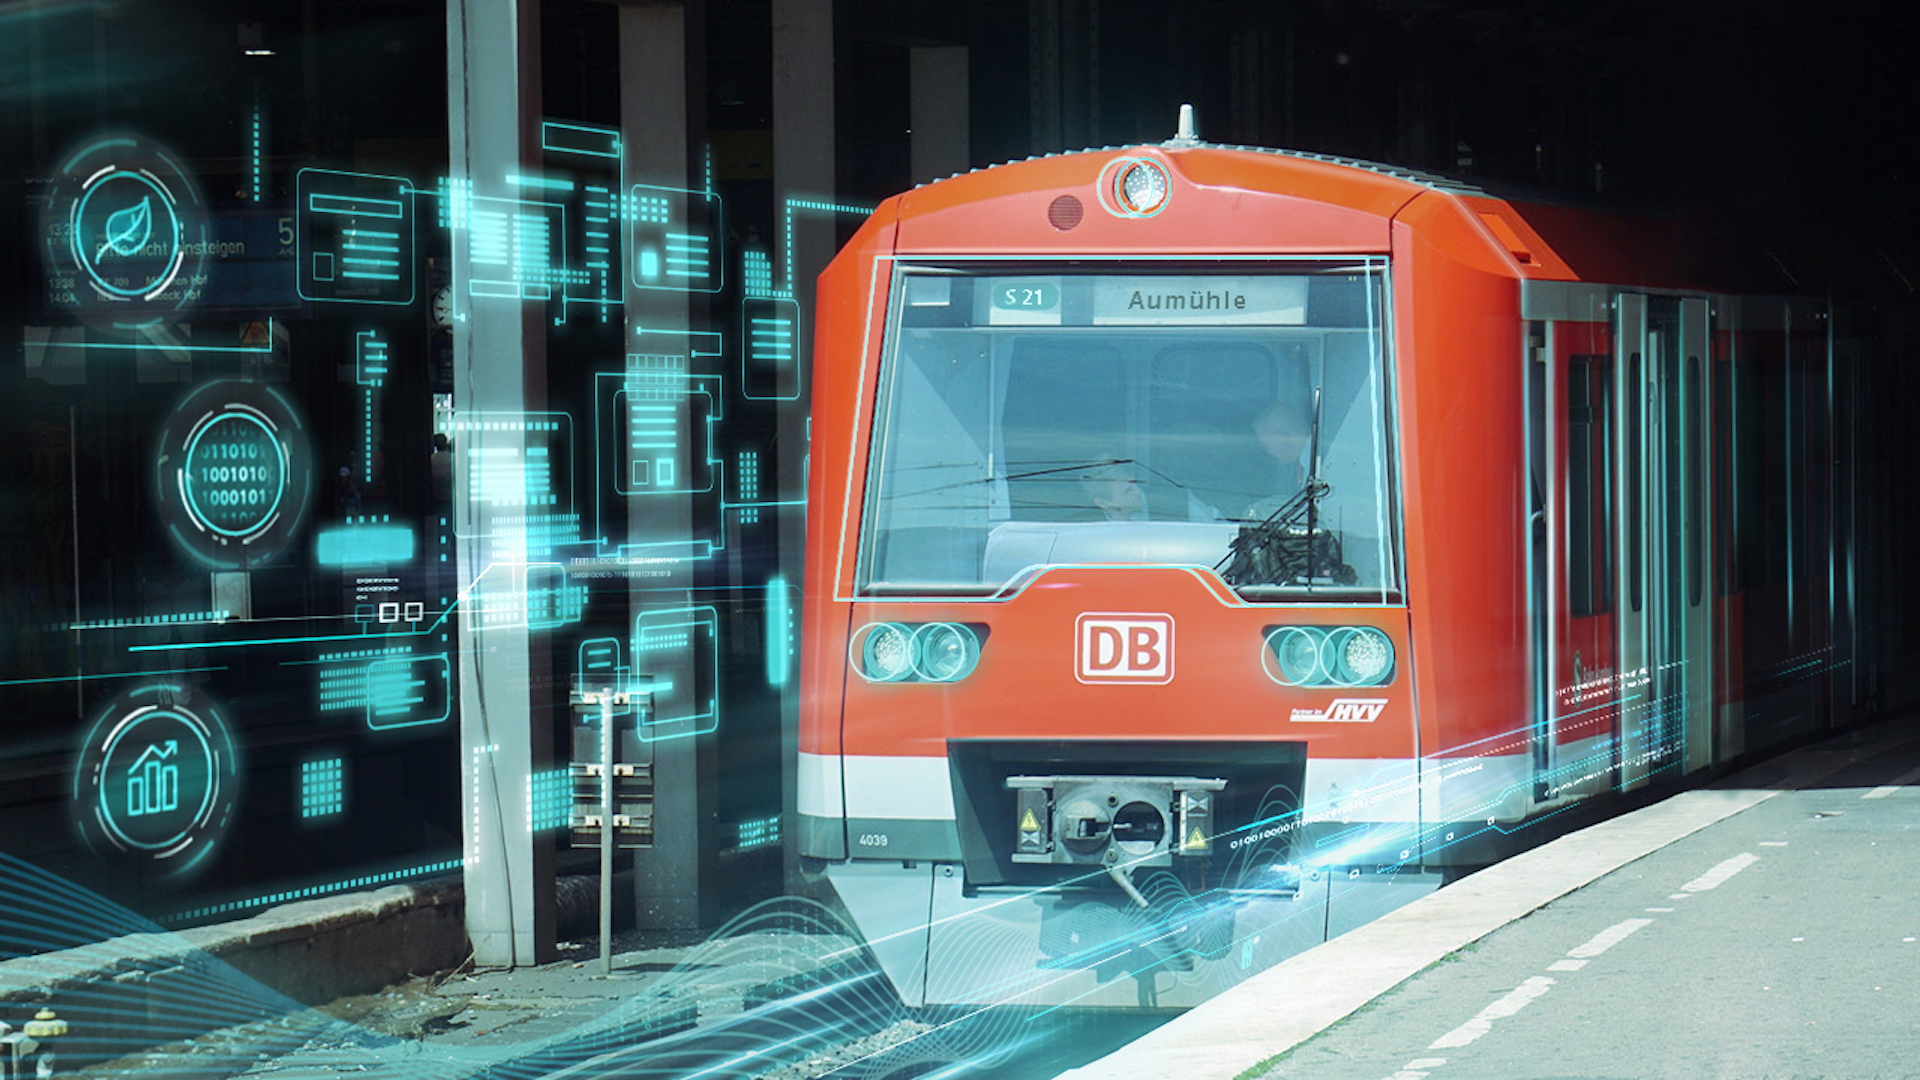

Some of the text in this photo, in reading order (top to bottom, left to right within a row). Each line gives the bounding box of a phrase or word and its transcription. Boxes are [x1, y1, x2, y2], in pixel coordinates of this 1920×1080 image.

[278, 217, 294, 245] 5
[1005, 288, 1042, 306] S 21
[1128, 290, 1246, 310] Aumühle
[1089, 626, 1161, 671] DB
[1332, 703, 1386, 721] HVV
[859, 834, 888, 847] 4039
